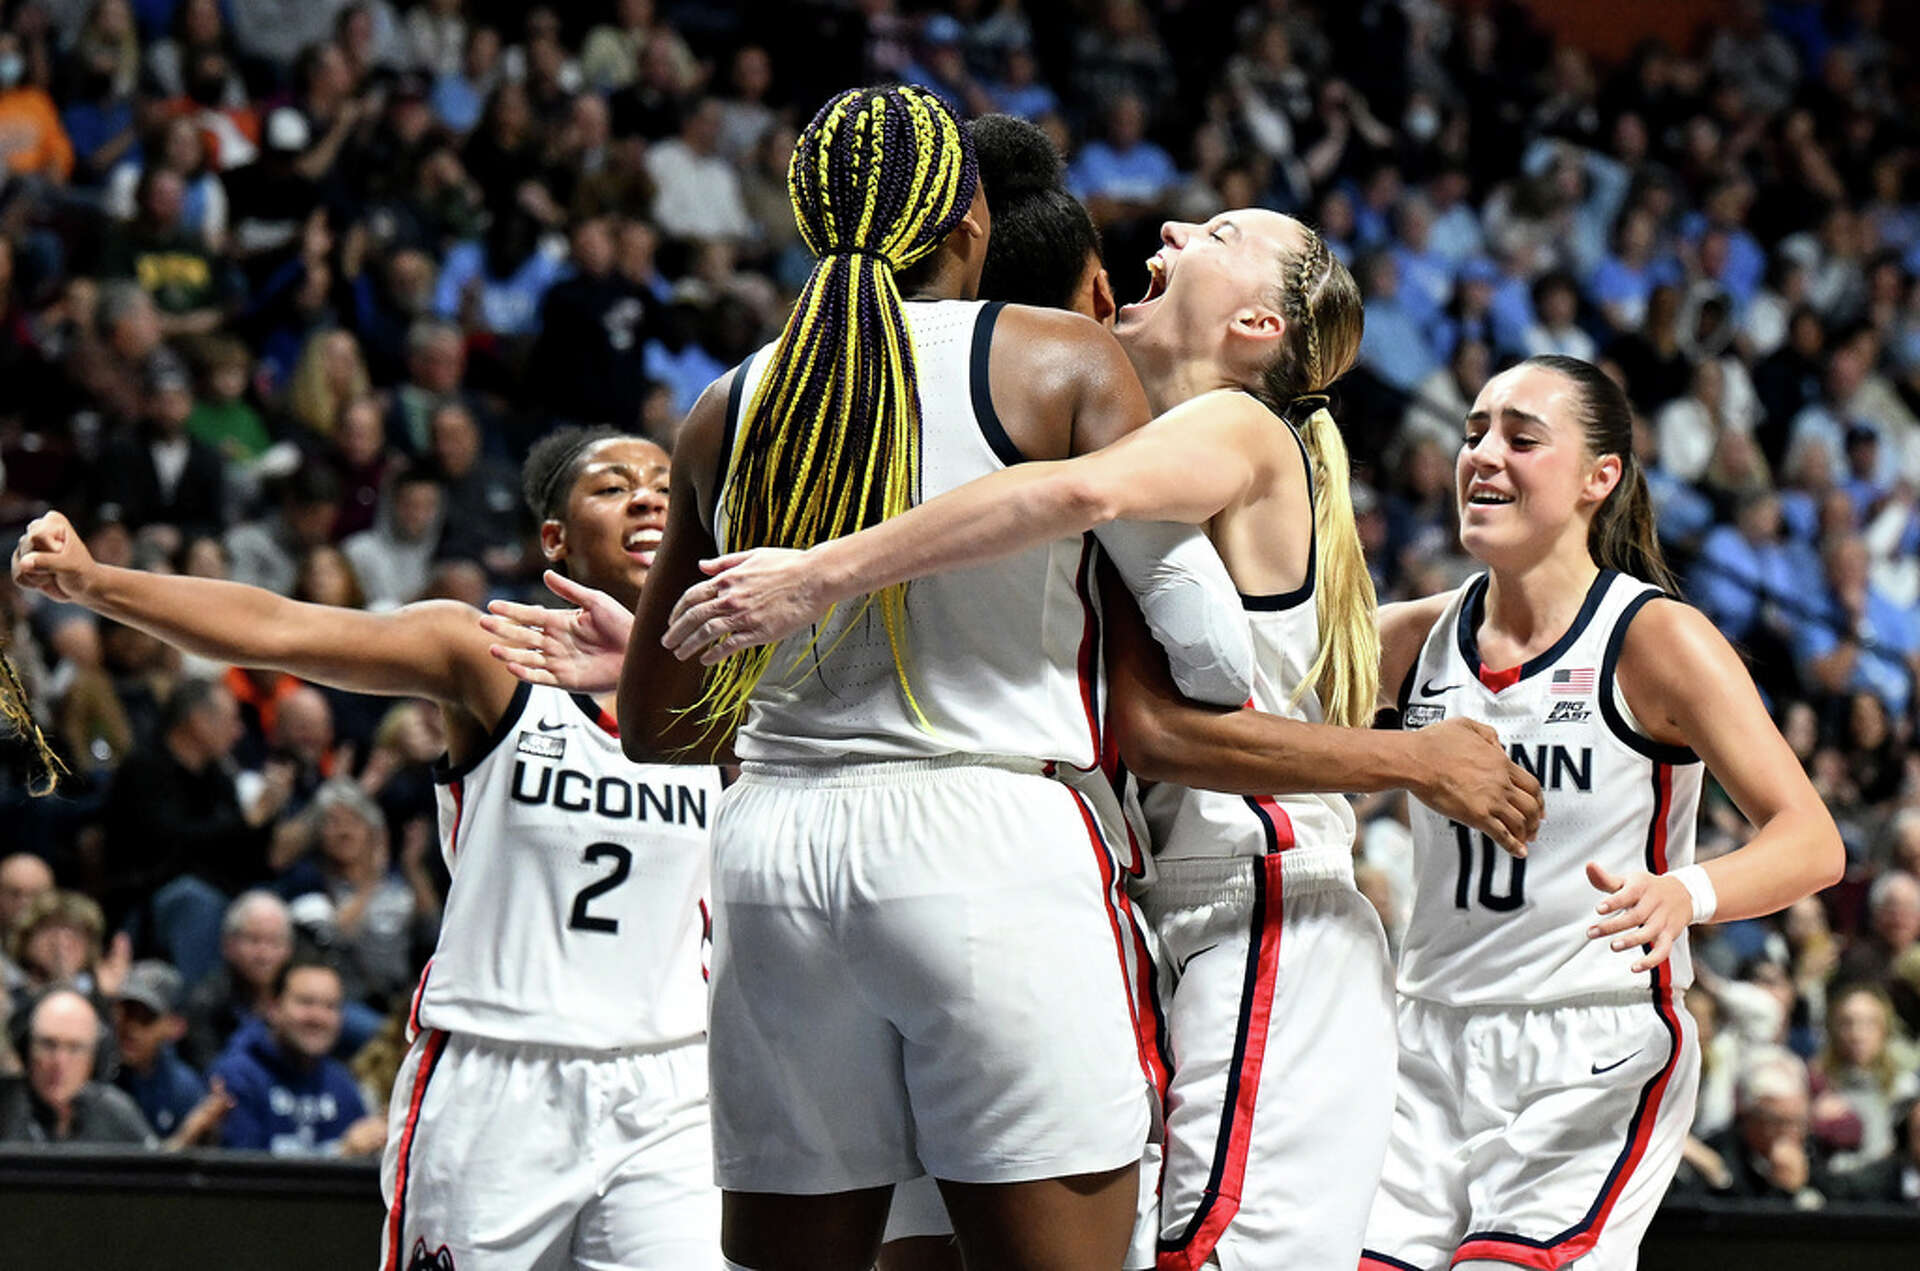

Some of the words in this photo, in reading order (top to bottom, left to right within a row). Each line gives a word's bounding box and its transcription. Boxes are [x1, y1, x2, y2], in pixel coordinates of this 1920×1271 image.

[1548, 711, 1592, 721] EAST
[1554, 701, 1586, 712] BIG
[511, 760, 706, 830] UCONN
[569, 842, 633, 935] 2
[1449, 819, 1526, 913] 10
